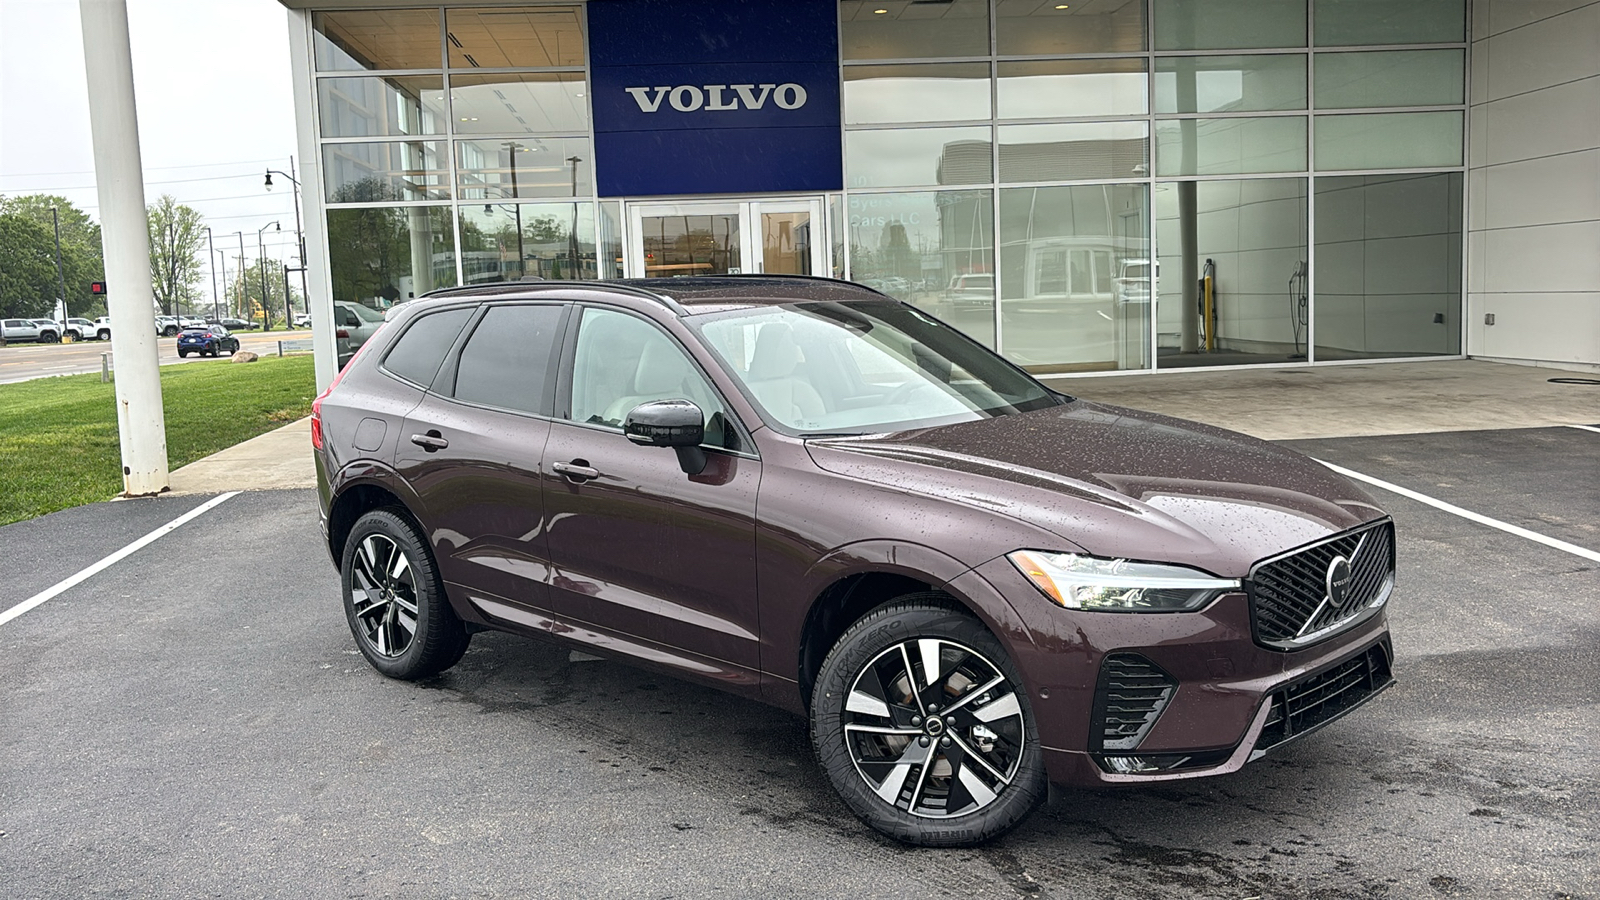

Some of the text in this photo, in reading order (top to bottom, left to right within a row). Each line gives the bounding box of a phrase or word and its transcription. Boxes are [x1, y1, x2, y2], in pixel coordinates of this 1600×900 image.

[625, 83, 807, 113] VOLVO
[850, 196, 892, 212] Byers
[850, 214, 885, 226] Cars
[369, 519, 388, 528] ZERO
[858, 620, 902, 649] ZERO
